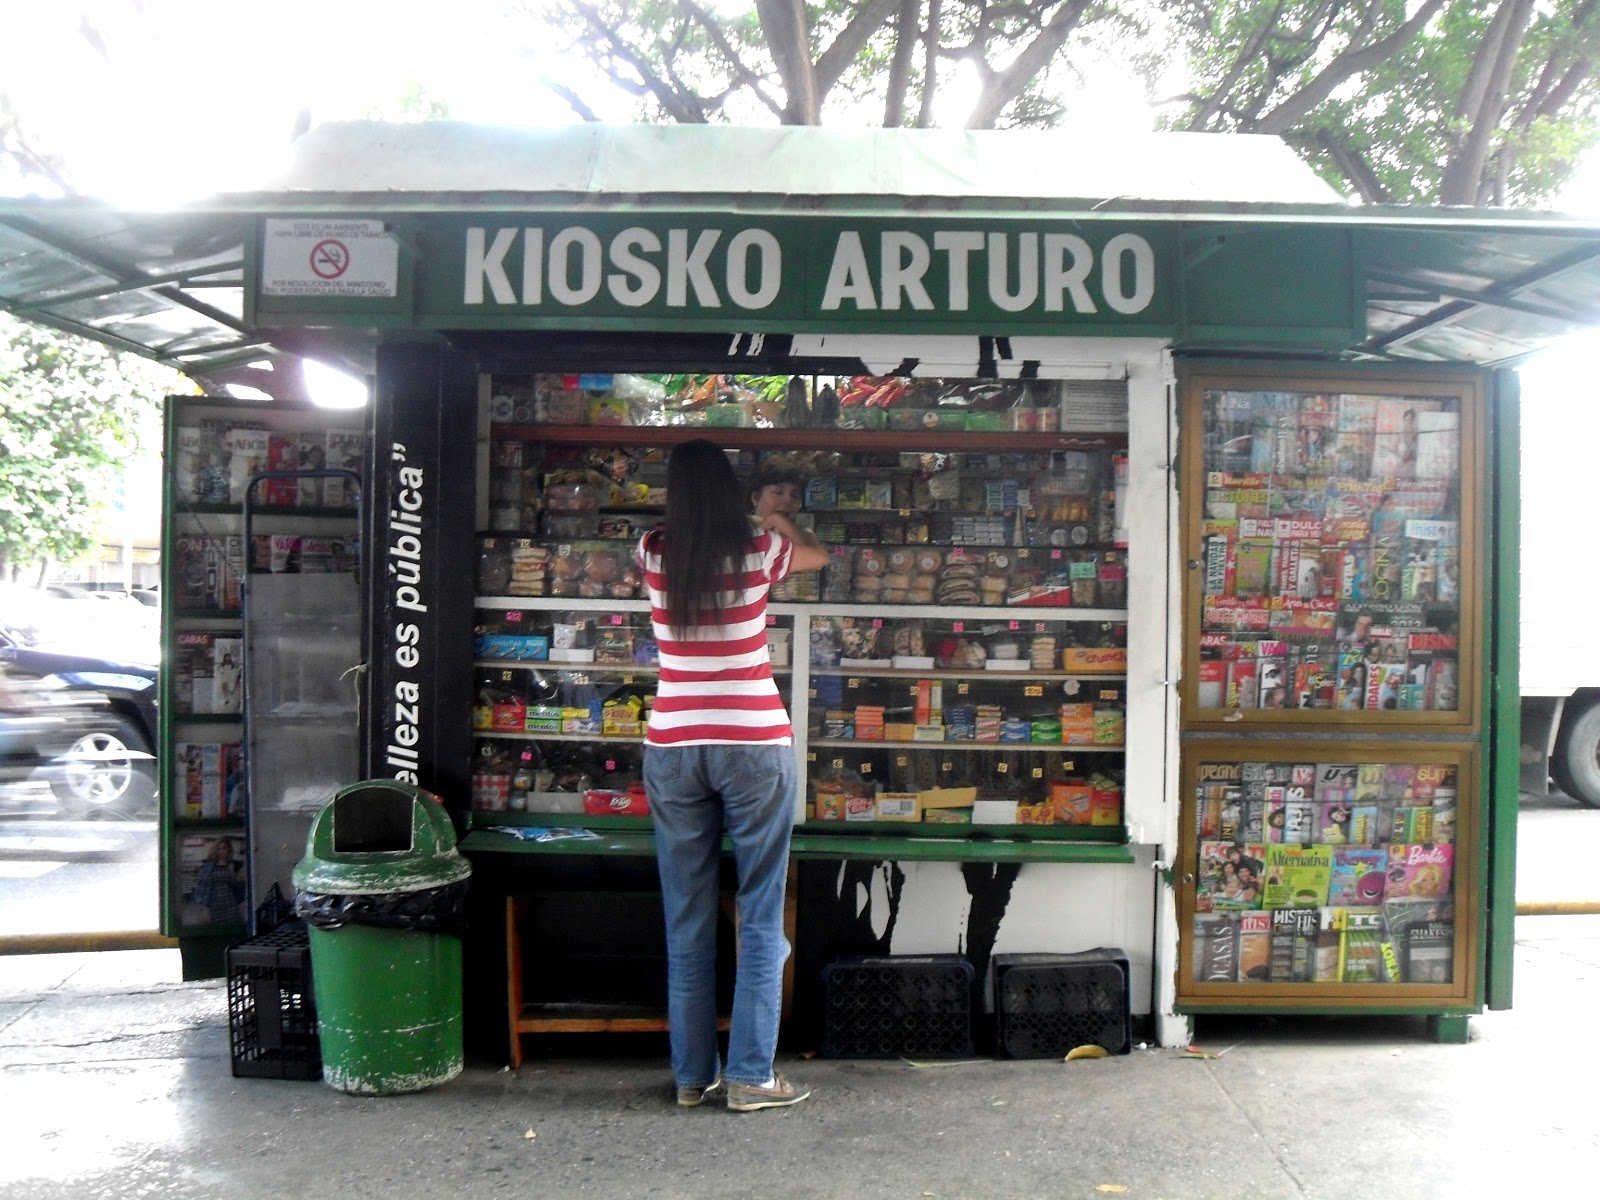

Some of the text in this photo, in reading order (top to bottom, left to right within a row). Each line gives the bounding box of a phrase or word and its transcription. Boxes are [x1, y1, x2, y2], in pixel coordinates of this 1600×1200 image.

[464, 227, 1154, 314] KIOSKO ARTURO
[388, 442, 426, 613] pública”
[1208, 540, 1220, 577] NAVIDAD
[177, 634, 208, 645] CARAS
[395, 622, 420, 668] es
[527, 722, 560, 731] mentos
[1272, 849, 1330, 868] Alternativa
[1407, 845, 1447, 866] Barbie
